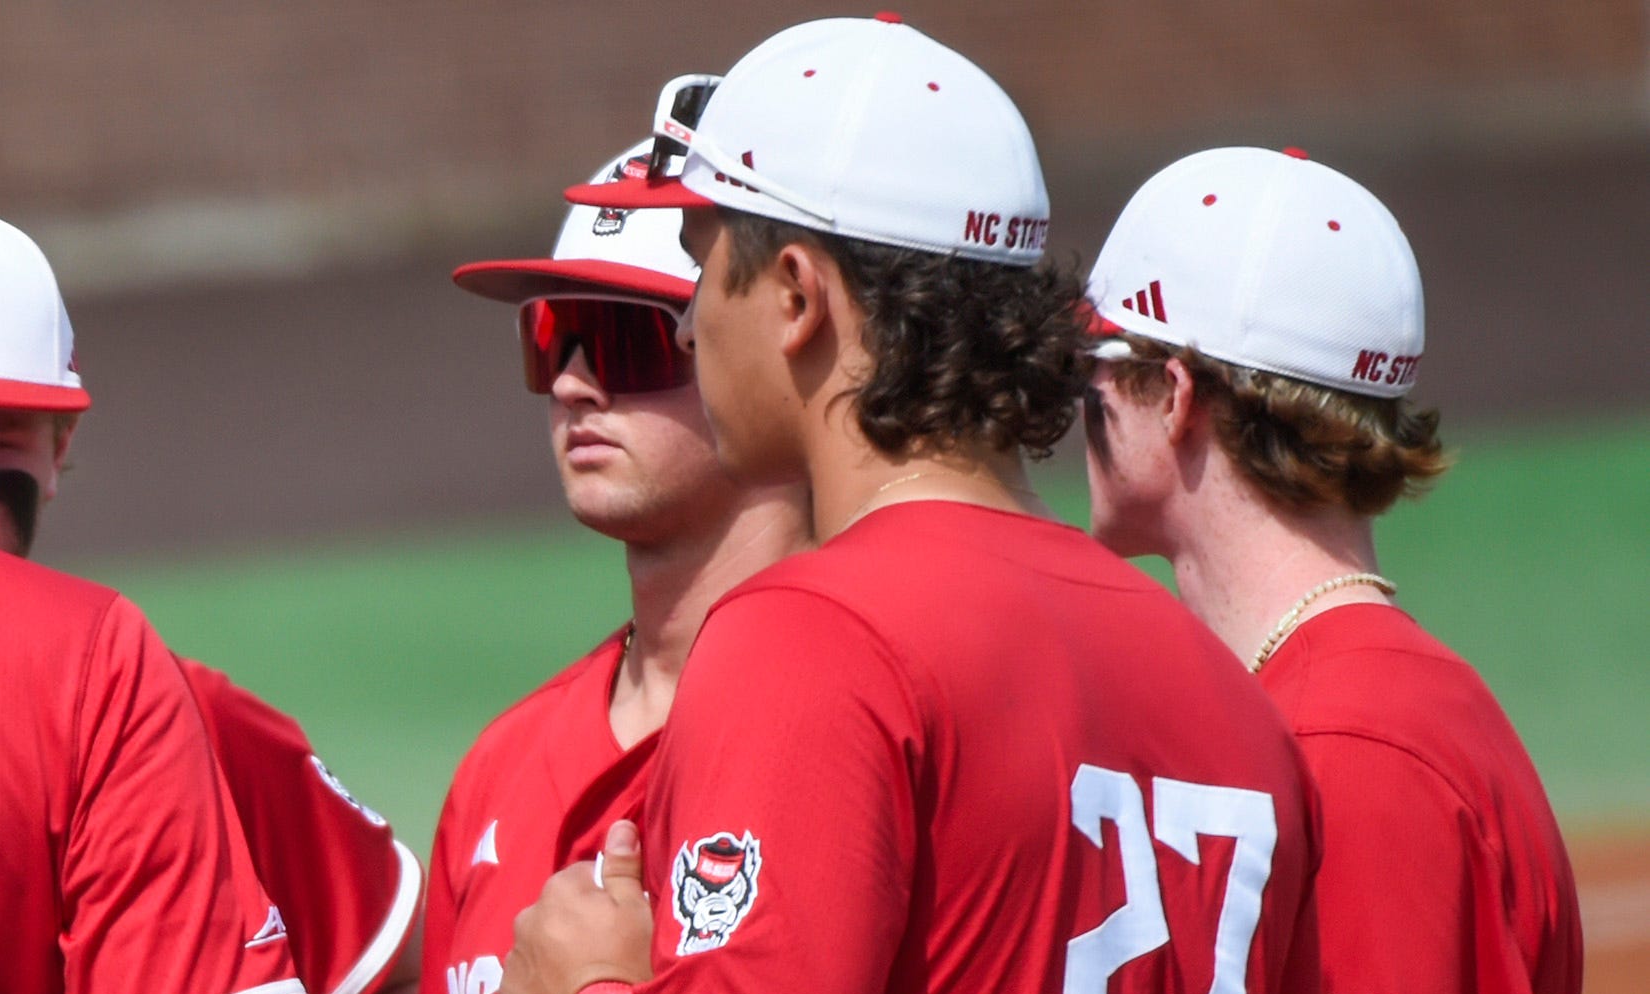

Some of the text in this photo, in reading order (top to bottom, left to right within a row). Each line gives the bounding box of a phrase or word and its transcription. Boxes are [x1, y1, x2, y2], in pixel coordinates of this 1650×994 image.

[964, 210, 1049, 250] NC STAT
[1351, 349, 1389, 383] NC
